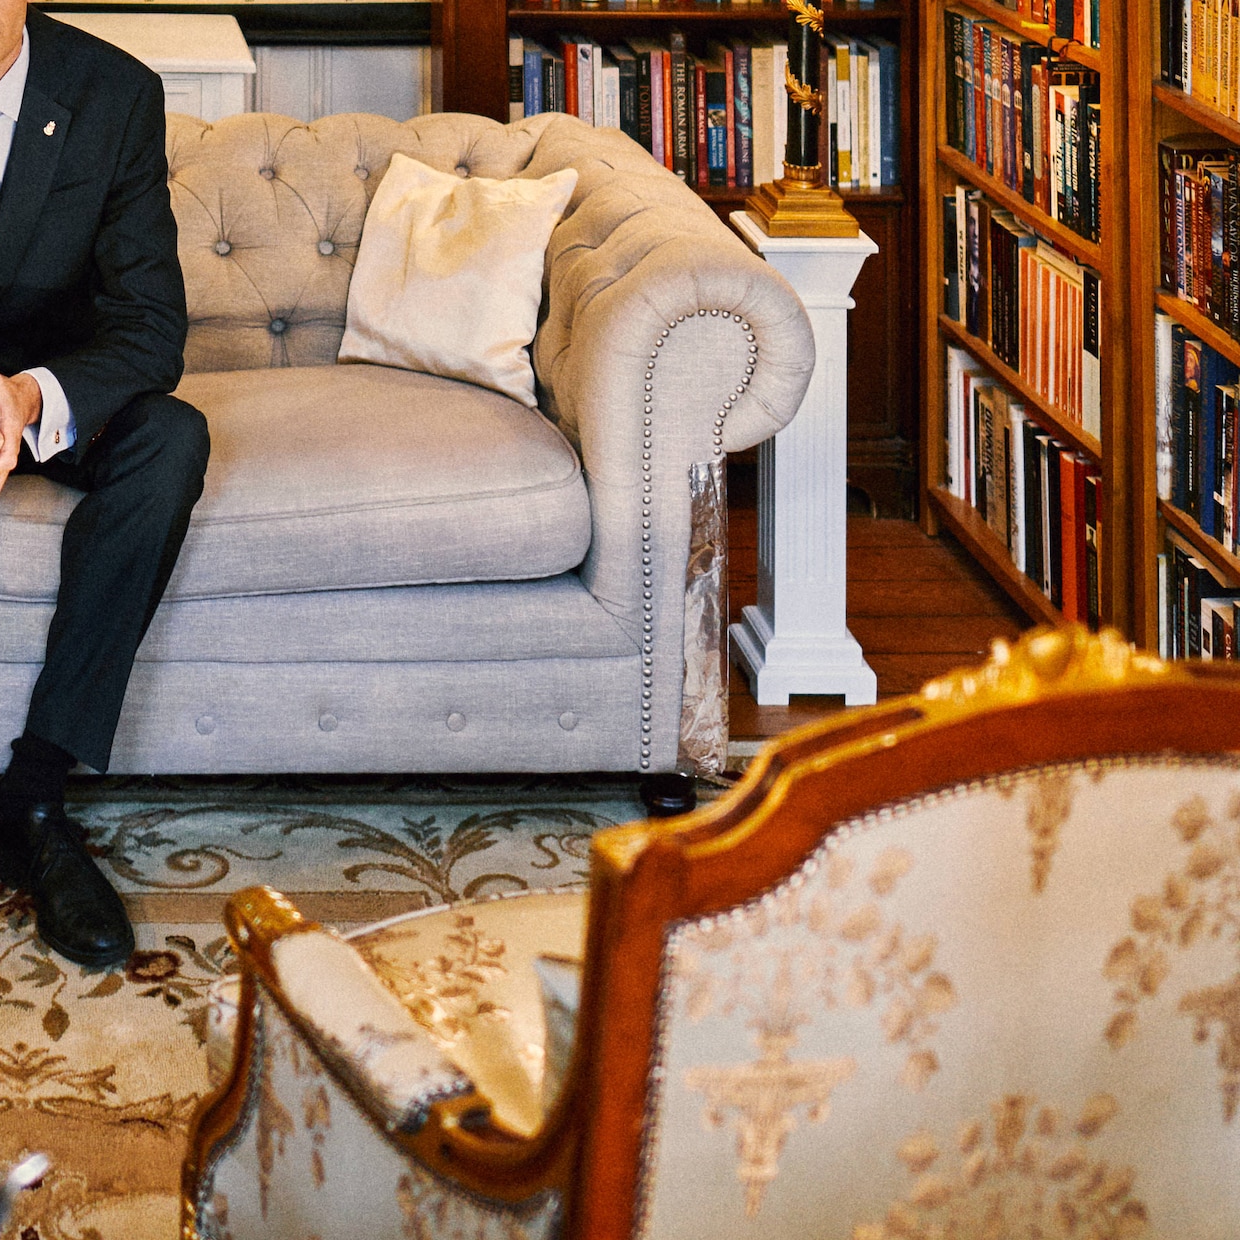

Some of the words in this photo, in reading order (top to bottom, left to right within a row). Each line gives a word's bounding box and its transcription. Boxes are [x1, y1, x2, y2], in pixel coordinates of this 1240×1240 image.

[676, 62, 686, 83] THE
[740, 57, 749, 74] THE
[638, 84, 650, 136] POMPEY
[676, 86, 686, 126] ROMAN
[740, 77, 749, 123] PATRICIAN
[677, 129, 687, 159] ARMY
[740, 126, 749, 163] TRIBUNE
[1070, 106, 1079, 142] Stella
[1071, 144, 1079, 191] RIMINGTON
[1229, 163, 1238, 214] STEVEN
[1229, 219, 1238, 263] SAYLOR
[985, 407, 994, 477] DUNKIRK
